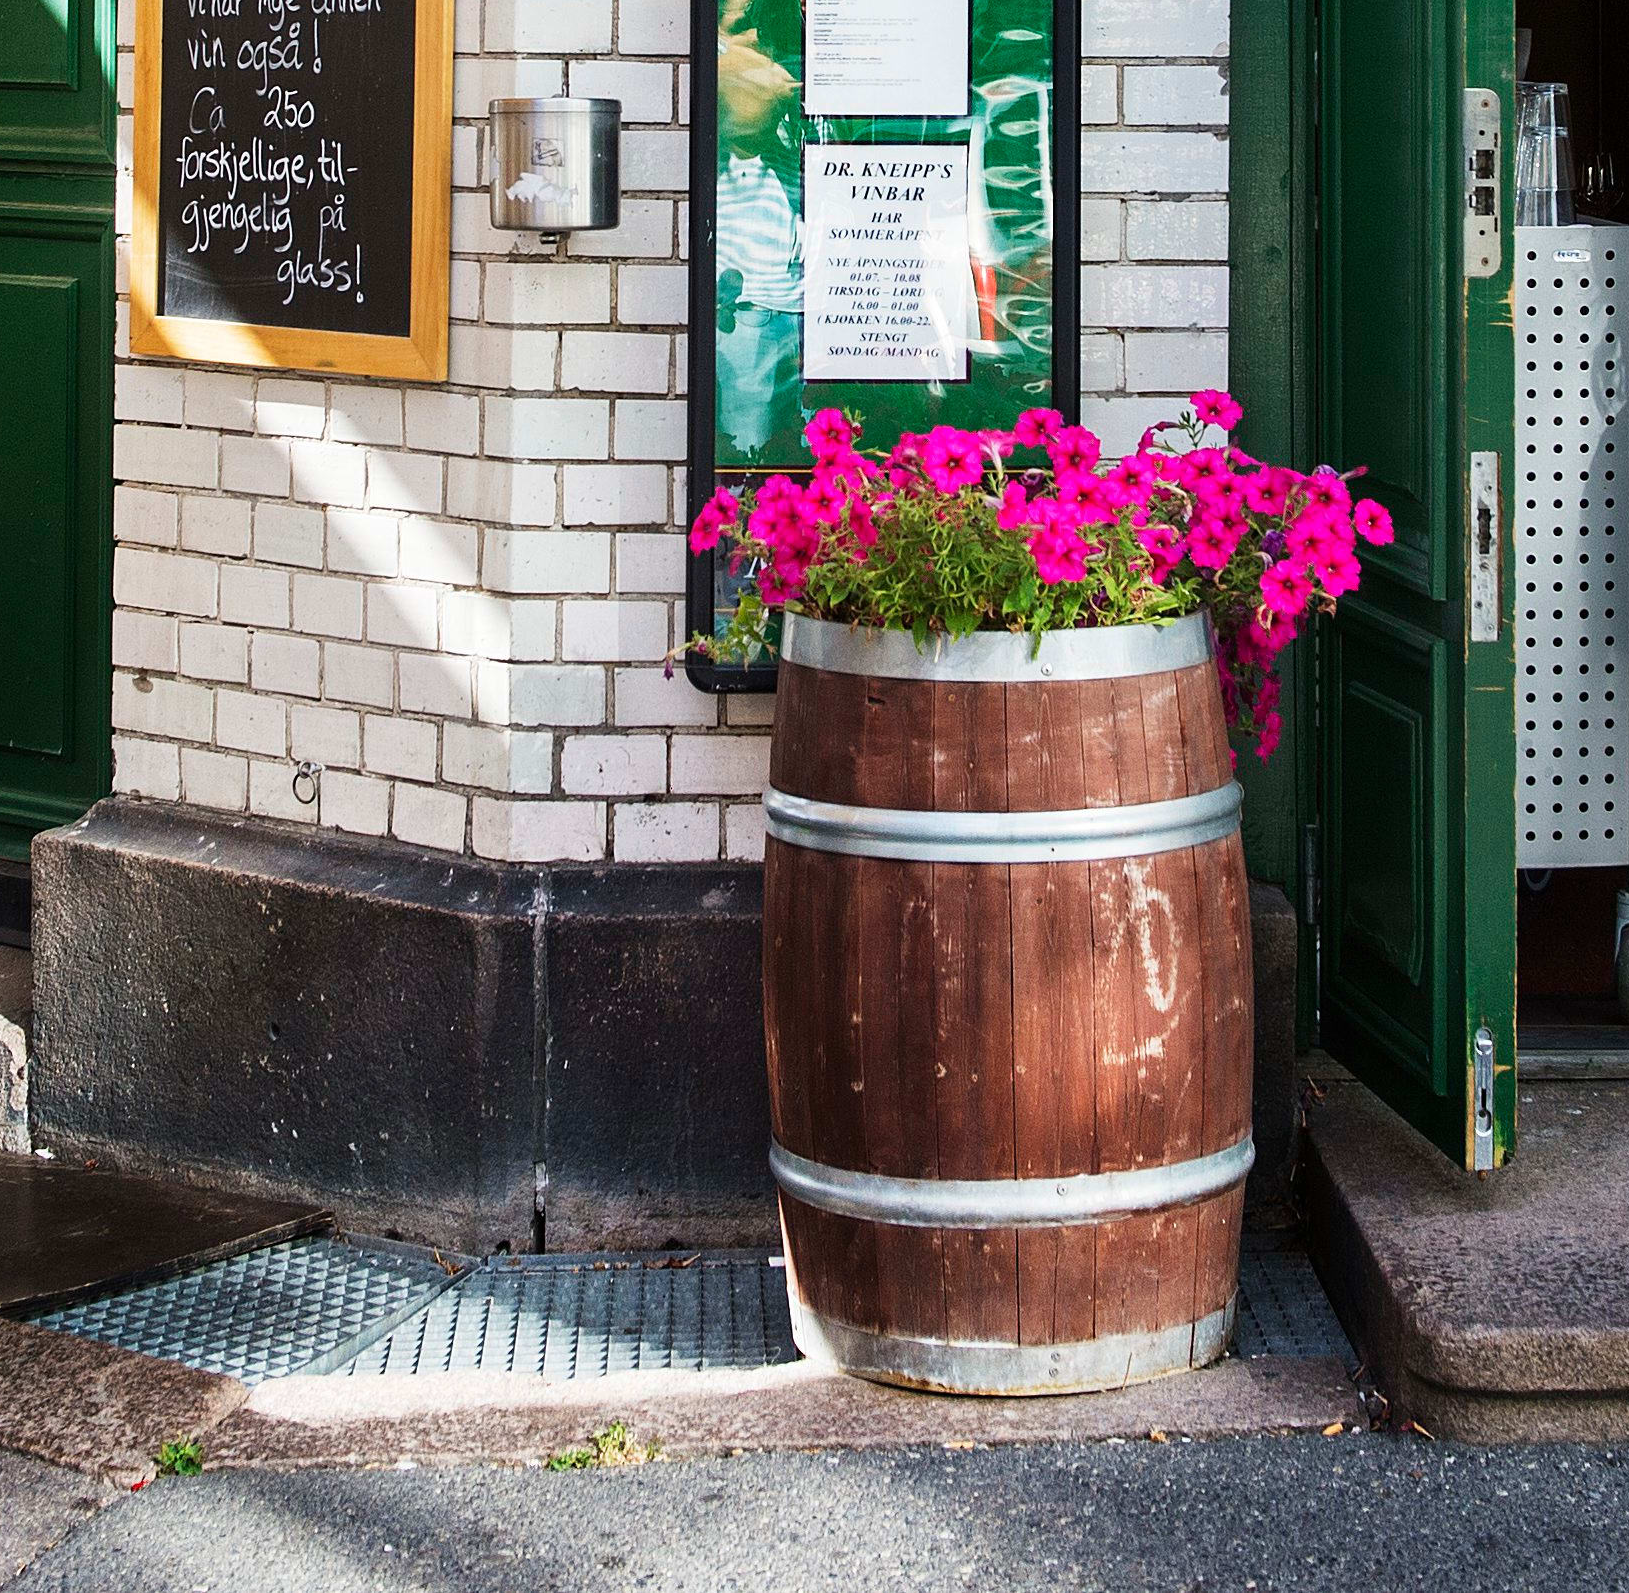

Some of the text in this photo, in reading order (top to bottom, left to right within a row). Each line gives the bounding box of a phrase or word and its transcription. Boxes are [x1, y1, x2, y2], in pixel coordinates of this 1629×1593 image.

[186, 29, 226, 71] vin
[188, 85, 315, 135] Ca 250
[823, 161, 854, 177] DR.
[850, 185, 925, 202] VINBAR
[870, 212, 902, 224] HAR
[181, 192, 347, 263] gjengelig på
[828, 286, 880, 297] TIRSDAG
[859, 332, 908, 343] STENGT
